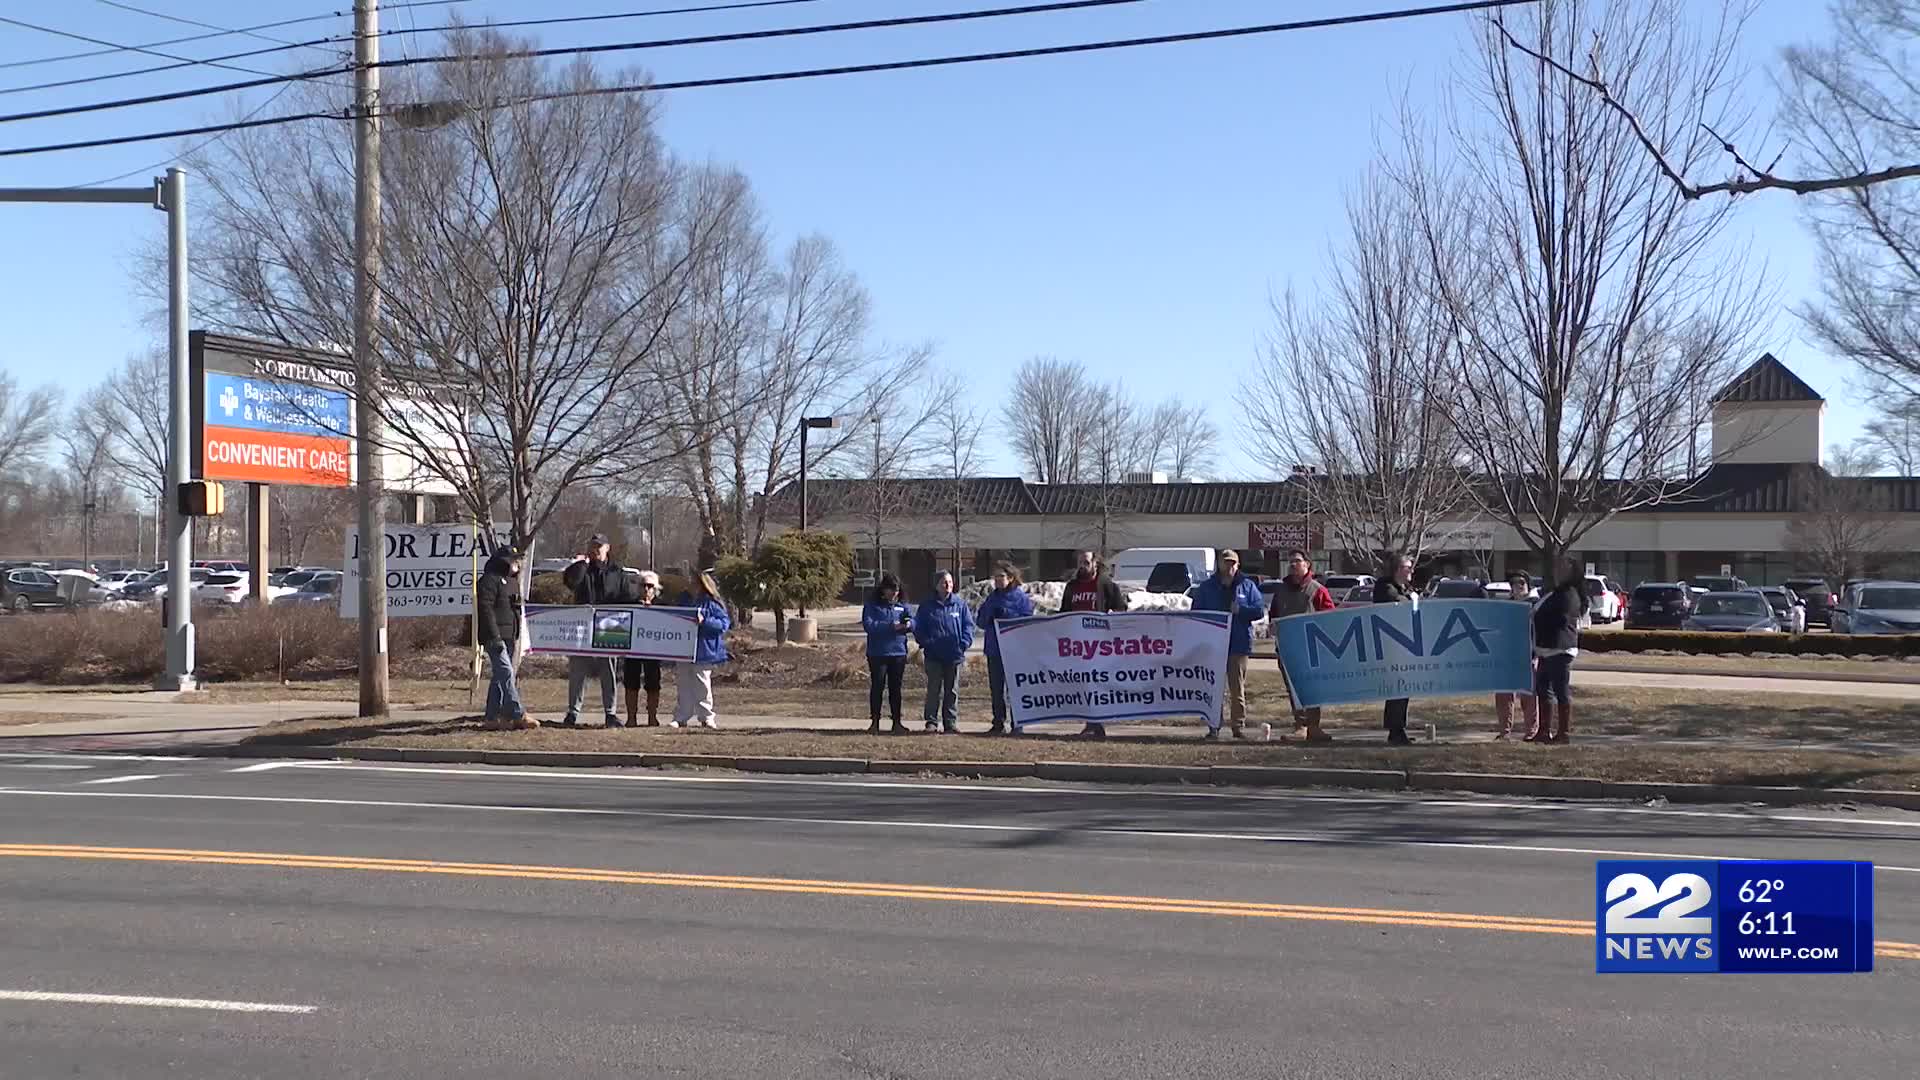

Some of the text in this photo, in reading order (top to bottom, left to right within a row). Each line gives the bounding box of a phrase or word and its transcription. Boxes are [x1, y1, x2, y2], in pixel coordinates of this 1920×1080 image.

[254, 358, 357, 387] NORTHAMPTO
[244, 404, 253, 421] &
[208, 440, 348, 473] CONVENIENT CARE
[386, 571, 456, 589] OLVEST
[388, 595, 442, 607] 363-9793
[637, 627, 691, 641] Region 1
[1304, 608, 1491, 669] MNA
[1058, 635, 1173, 660] Baystate:
[1015, 665, 1215, 687] Put Patients over Profits
[1021, 691, 1082, 709] Support
[1084, 690, 1154, 706] Visiting
